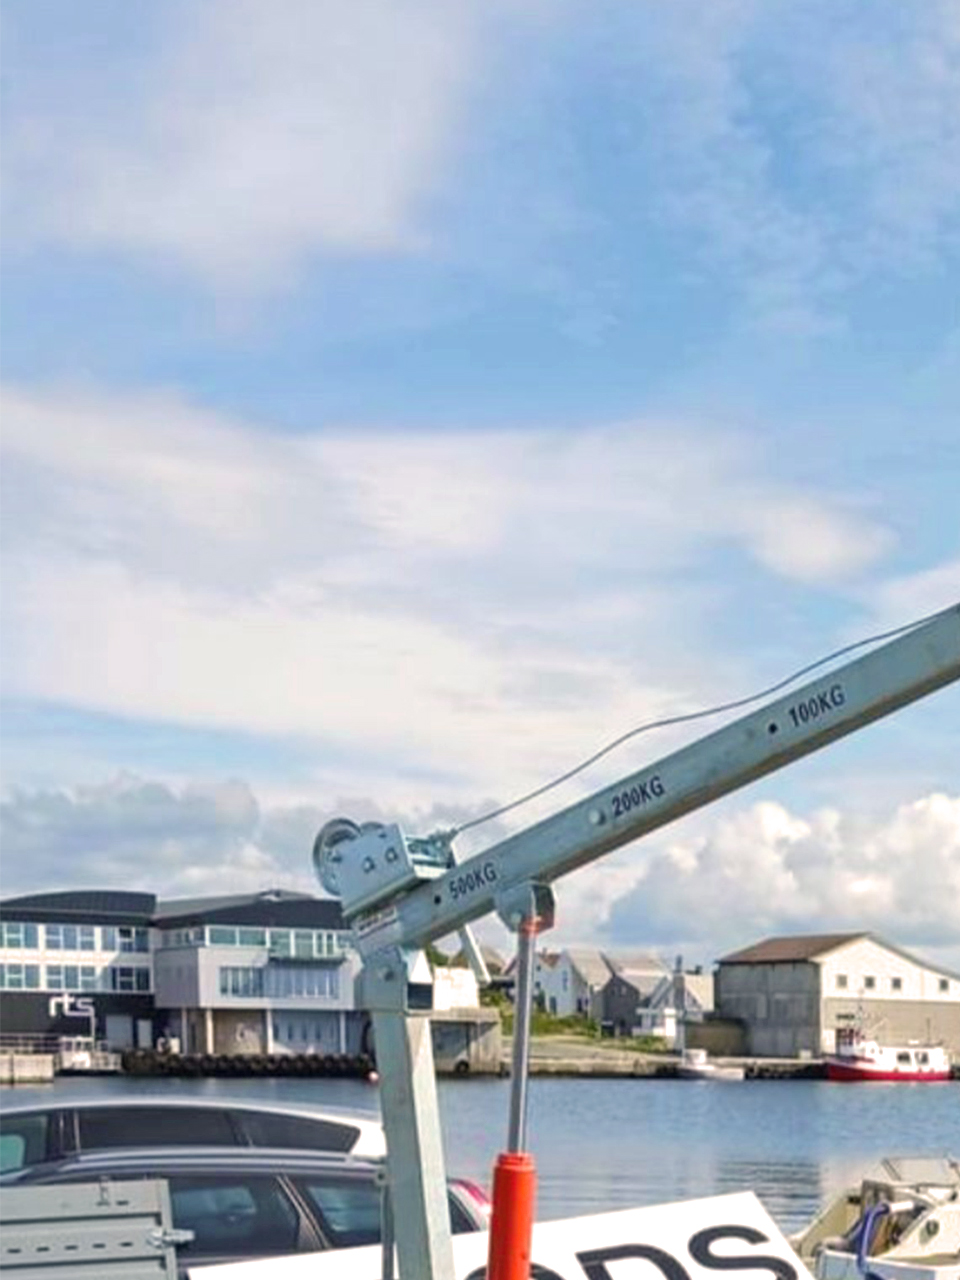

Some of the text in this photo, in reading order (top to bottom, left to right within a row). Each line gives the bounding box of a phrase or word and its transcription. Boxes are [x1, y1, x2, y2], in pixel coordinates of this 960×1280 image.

[788, 684, 845, 727] 100KG
[612, 775, 665, 817] 200KG
[449, 862, 497, 899] 500KG
